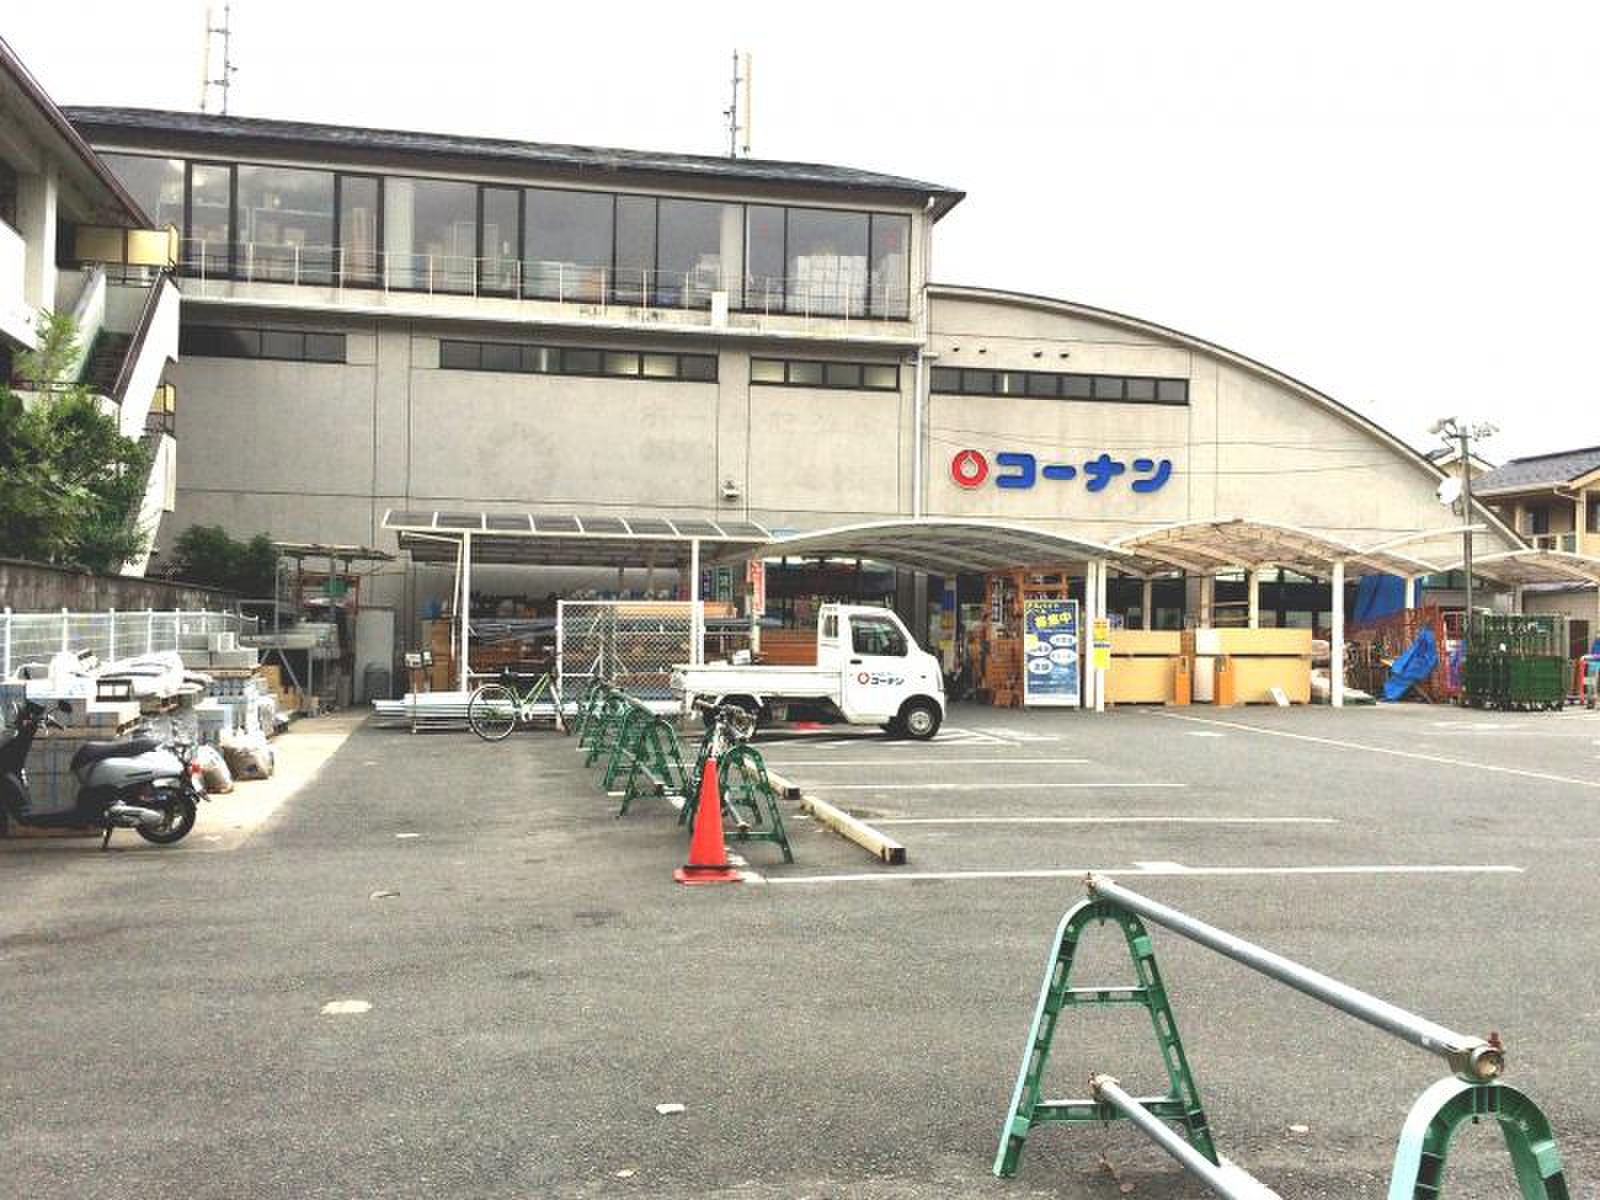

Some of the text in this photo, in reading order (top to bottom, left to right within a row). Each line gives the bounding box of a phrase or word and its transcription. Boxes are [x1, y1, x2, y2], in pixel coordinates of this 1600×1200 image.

[996, 452, 1172, 492] コーナン
[871, 677, 904, 686] コーナン
